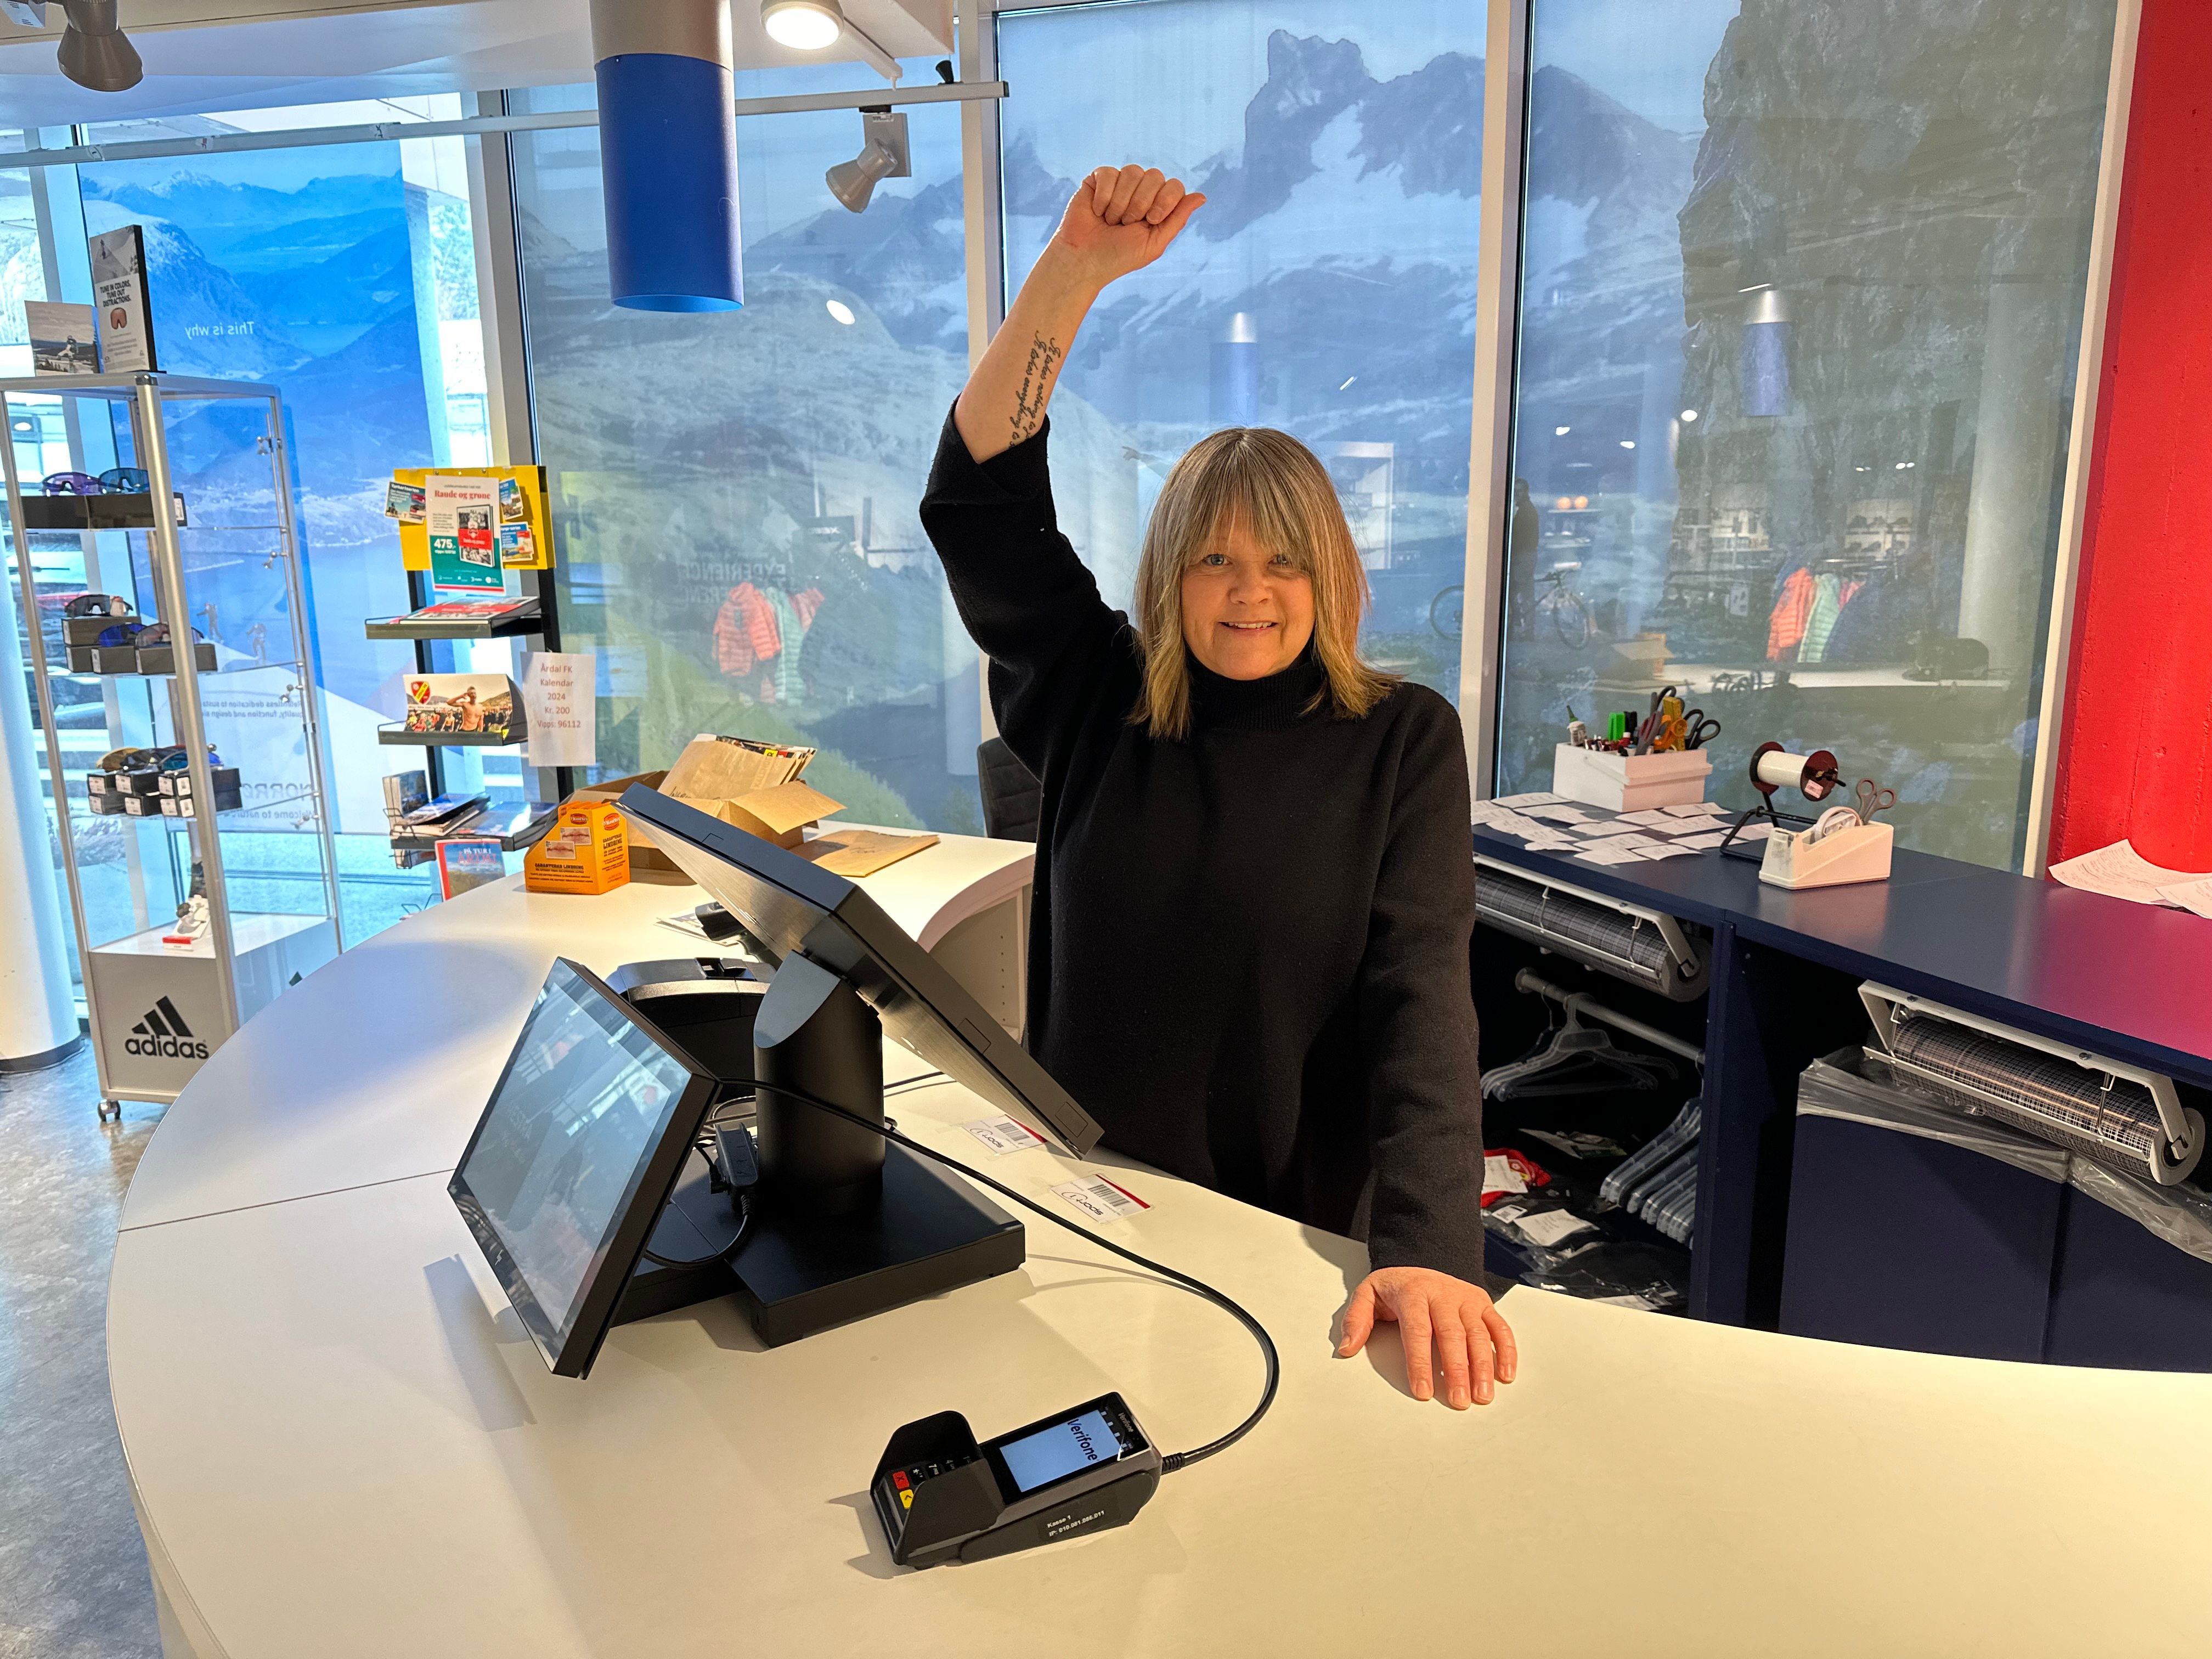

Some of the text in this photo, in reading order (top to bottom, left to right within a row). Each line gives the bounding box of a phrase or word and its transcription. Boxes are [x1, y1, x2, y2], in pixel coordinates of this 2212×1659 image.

[100, 285, 109, 294] TUNE
[106, 290, 117, 299] TUNE
[1034, 330, 1047, 353] It
[1048, 337, 1061, 358] It
[1025, 348, 1040, 376] takes
[1040, 354, 1054, 379] takes
[1010, 377, 1030, 428] everything
[1027, 382, 1044, 419] nothing
[1012, 431, 1020, 440] to
[1029, 421, 1036, 430] to
[435, 490, 457, 499] Raude
[458, 492, 468, 500] og
[540, 663, 561, 673] Årdal
[537, 720, 556, 729] Vipps:
[125, 1035, 210, 1059] adidas
[1118, 1412, 1134, 1432] Verifone
[1067, 1418, 1098, 1460] Verifone
